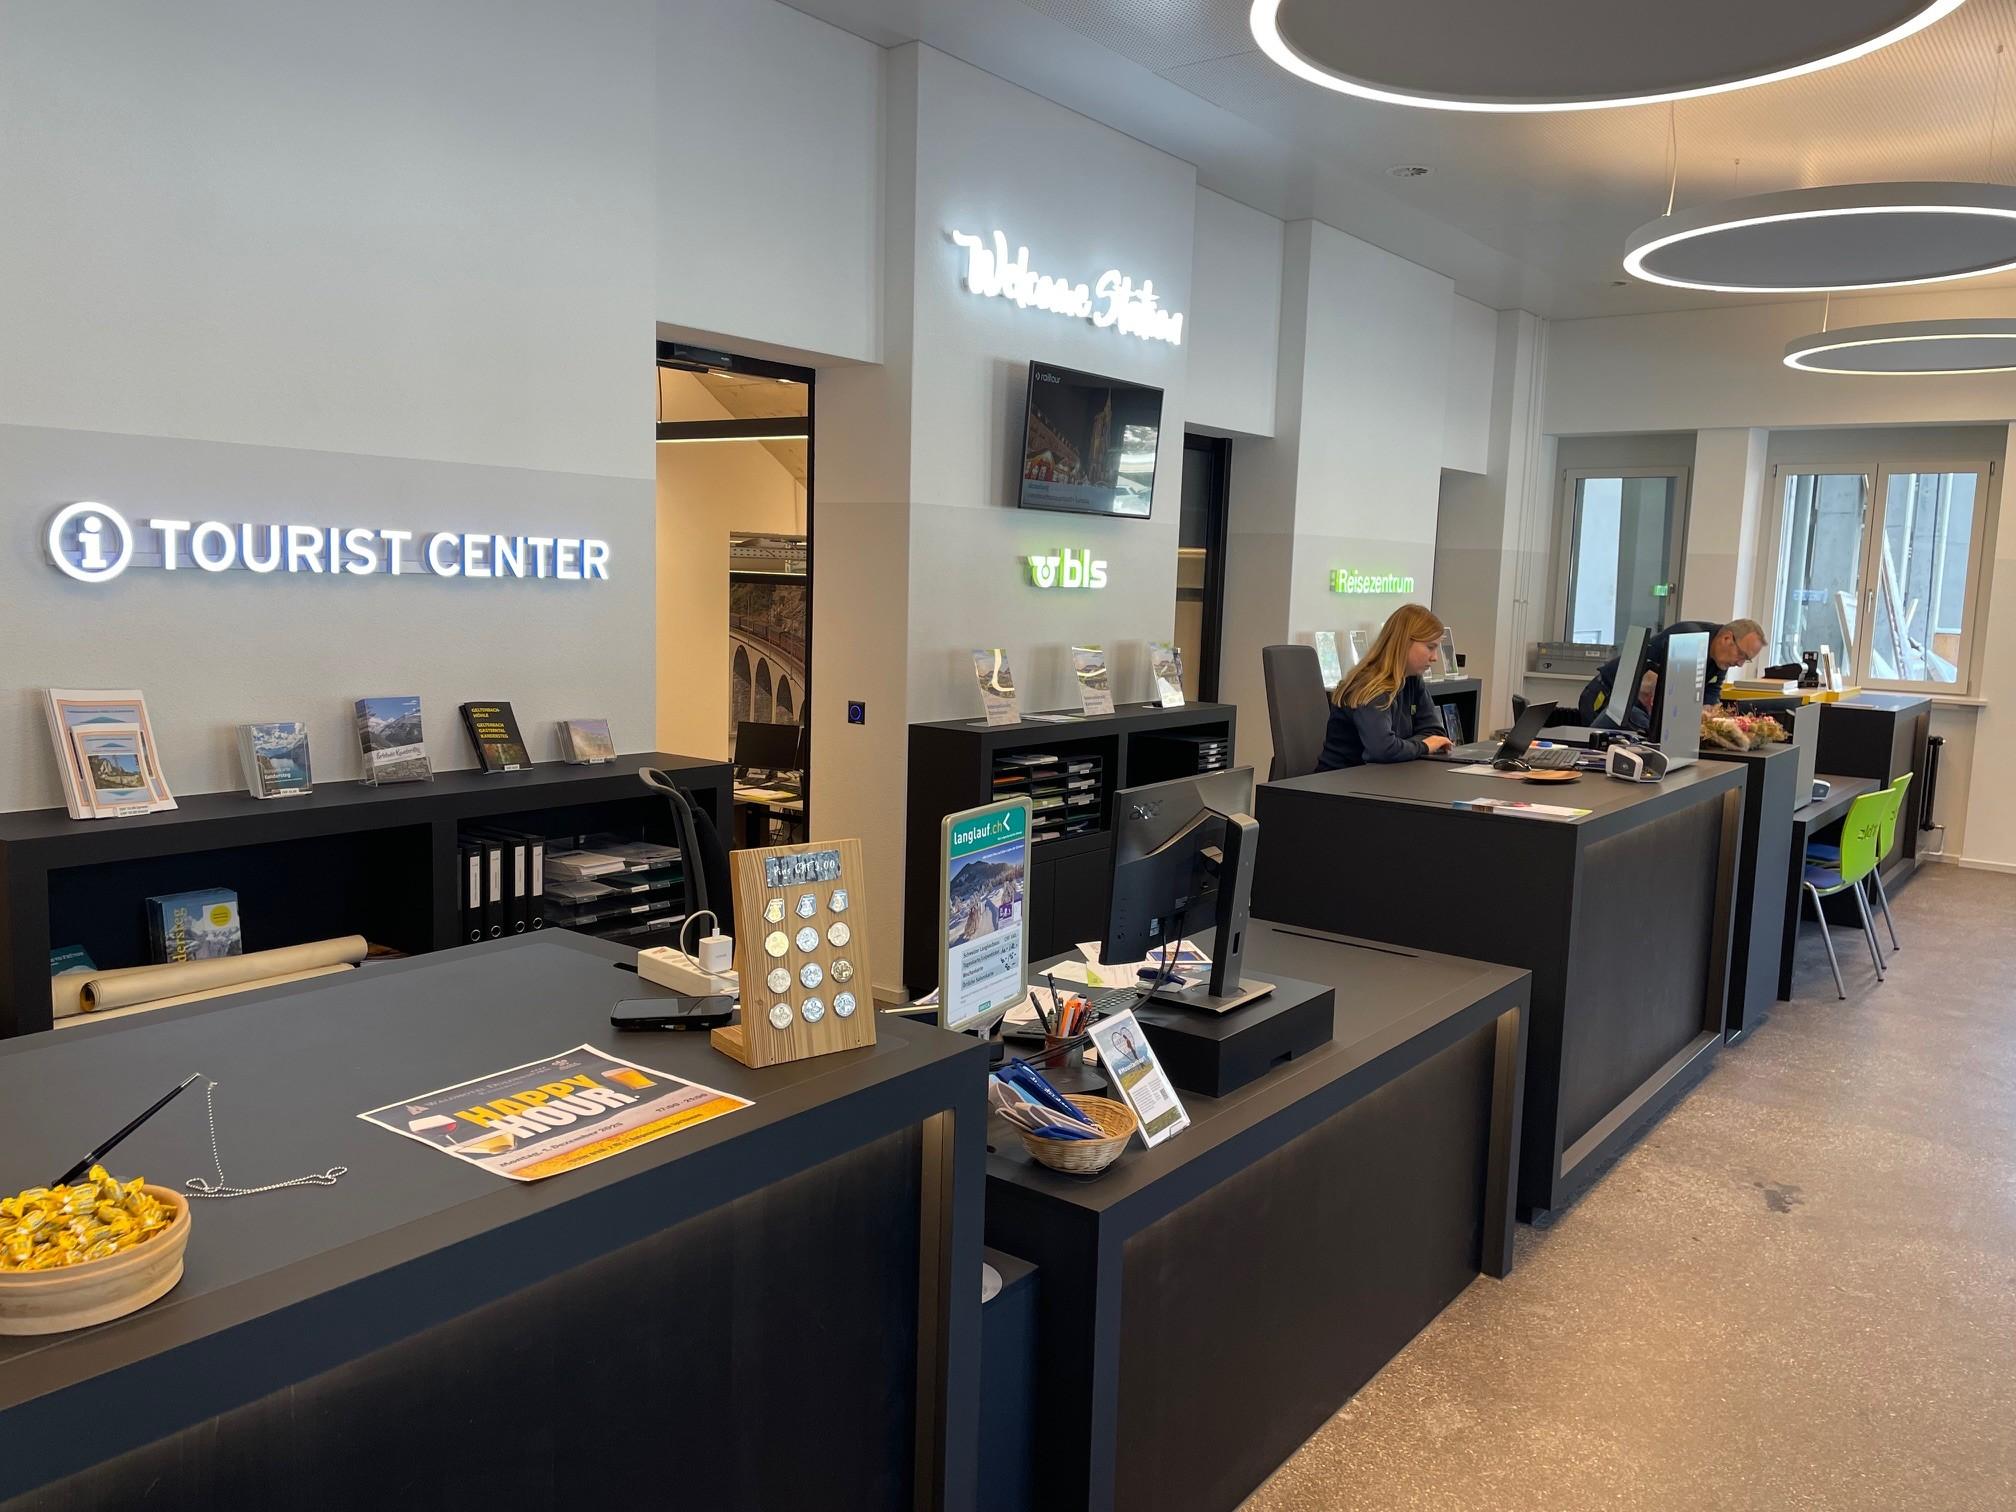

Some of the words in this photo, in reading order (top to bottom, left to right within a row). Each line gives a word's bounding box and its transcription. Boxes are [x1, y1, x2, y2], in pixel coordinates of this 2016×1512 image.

[150, 518, 412, 576] TOURIST
[428, 532, 610, 580] CENTER
[1063, 548, 1107, 588] bls
[1338, 568, 1414, 593] Reisezentrum
[954, 820, 1003, 845] langlauf.ch
[453, 1073, 604, 1128] HAPPY
